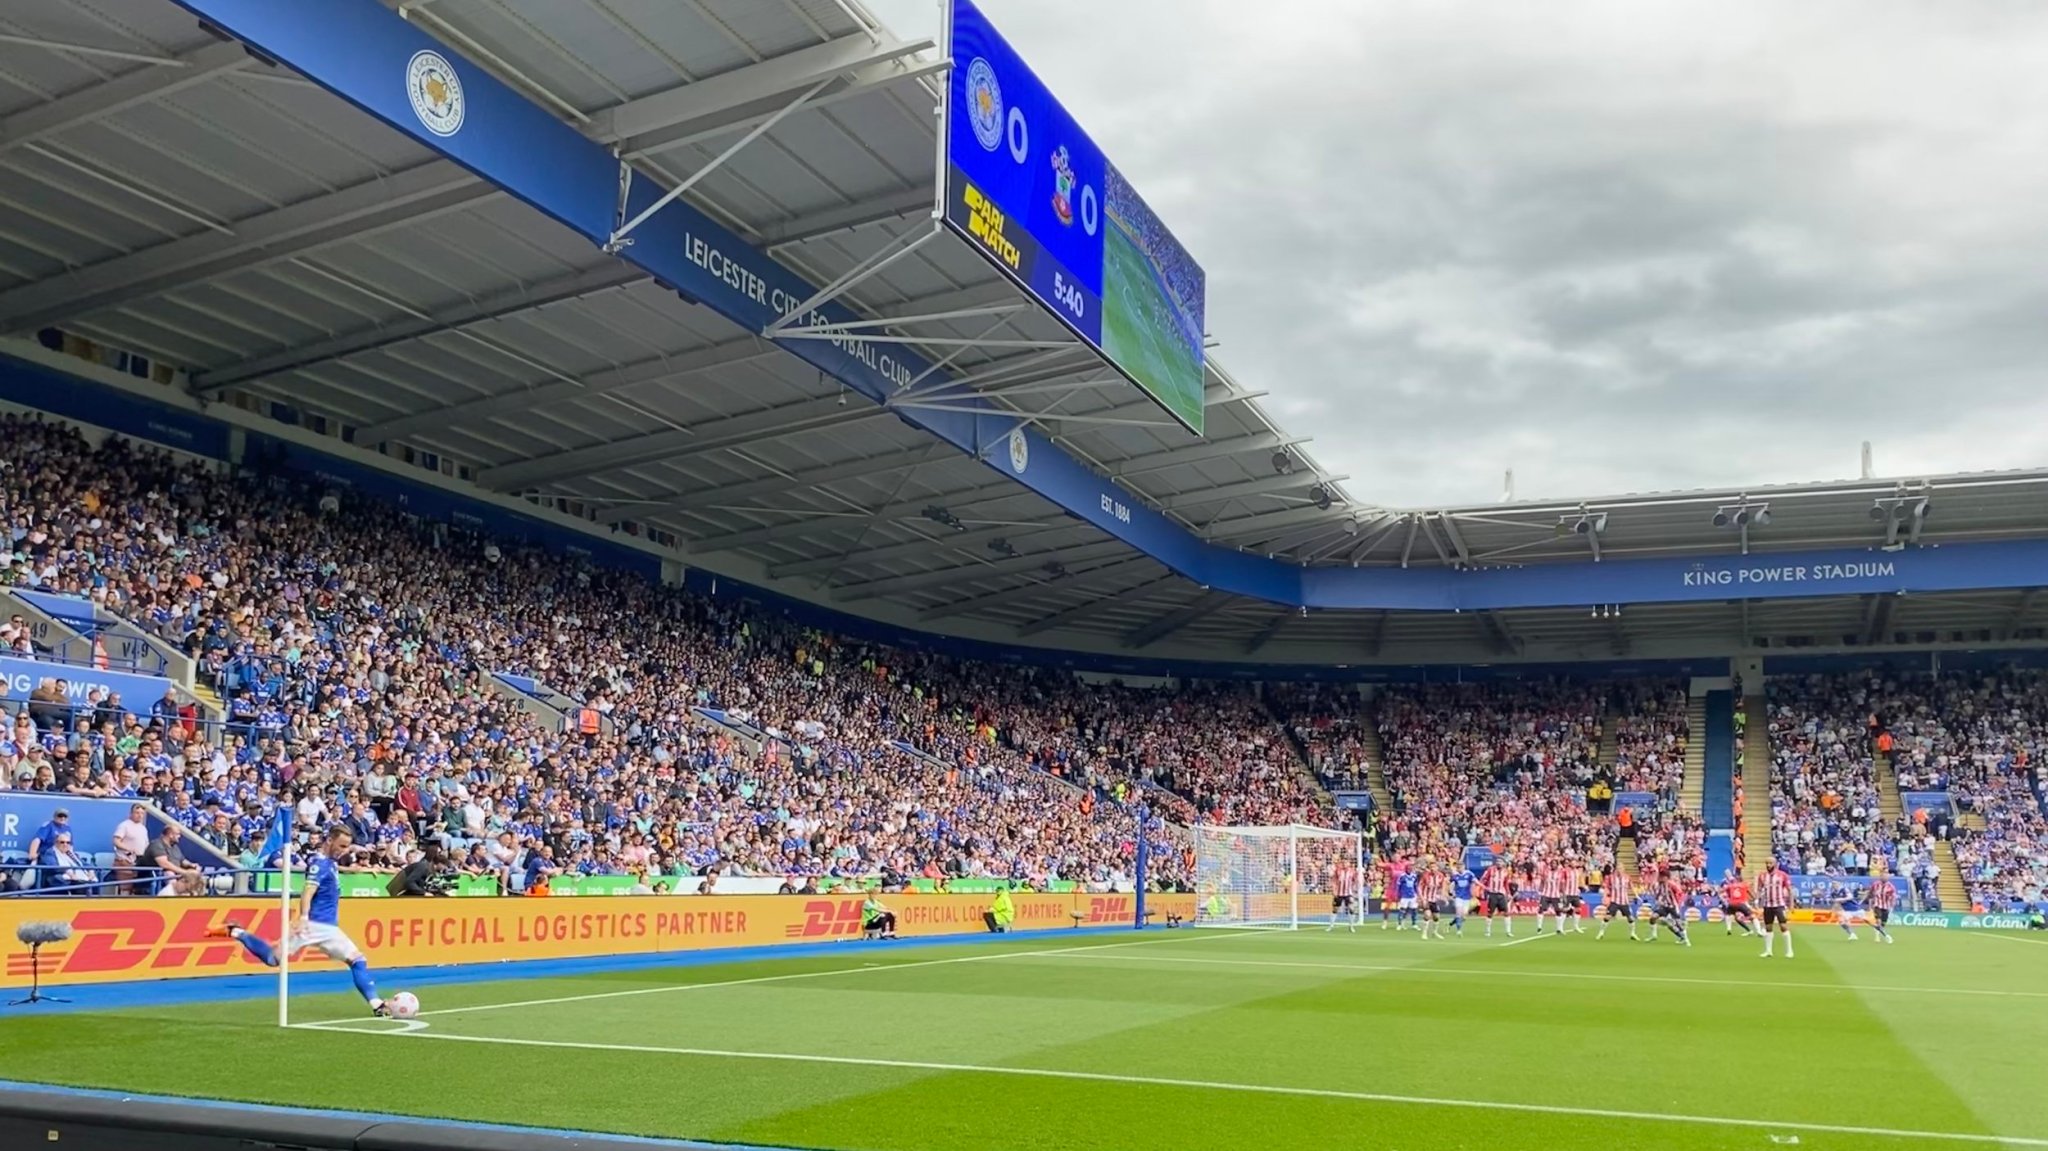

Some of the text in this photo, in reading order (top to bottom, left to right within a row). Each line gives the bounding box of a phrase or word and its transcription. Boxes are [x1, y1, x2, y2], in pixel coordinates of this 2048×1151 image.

[1008, 106, 1028, 164] 0
[972, 187, 1005, 233] PARI
[1081, 184, 1098, 236] 0
[975, 217, 1021, 270] MATCH
[685, 232, 767, 306] LEICESTER
[880, 355, 912, 391] CLUB
[1054, 271, 1084, 318] 5:40
[1101, 493, 1114, 516] EST.
[1683, 562, 1895, 586] KING POWER STADIUM
[122, 641, 149, 658] V9
[802, 900, 865, 937] DH
[904, 903, 959, 924] OFFICIAL
[1022, 903, 1063, 920] PARTNER
[1090, 897, 1130, 922] DHL
[1903, 912, 1949, 928] Chang
[364, 910, 747, 949] OFFICIAL LOGISTICS PARTNER
